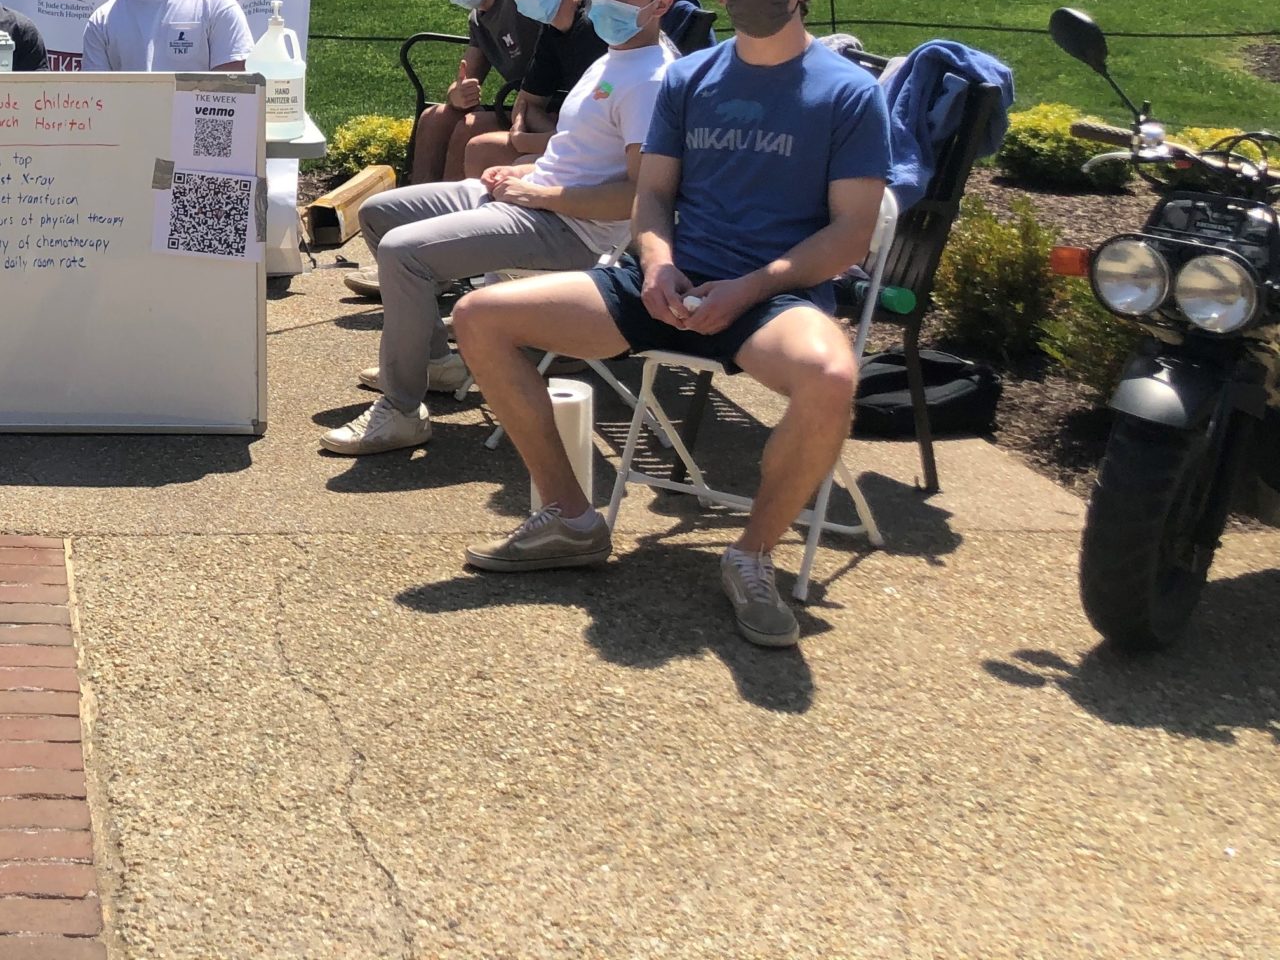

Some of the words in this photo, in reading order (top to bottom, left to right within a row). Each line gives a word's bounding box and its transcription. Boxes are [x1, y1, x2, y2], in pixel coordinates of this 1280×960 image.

[45, 1, 59, 9] Jude
[37, 7, 65, 17] Research
[274, 87, 290, 96] HAND
[195, 94, 211, 102] TKE
[213, 94, 237, 104] WEEK
[195, 106, 235, 118] venmo
[35, 117, 92, 131] Hospital
[685, 127, 753, 151] NIKAU
[753, 129, 794, 157] KAI
[17, 193, 79, 206] transfusion
[20, 214, 34, 226] of
[40, 214, 80, 229] physical
[87, 214, 125, 228] therapy
[1195, 221, 1233, 232] HONDA
[18, 235, 31, 250] of
[36, 234, 110, 255] chemotherapy
[4, 254, 28, 272] daily
[33, 258, 55, 268] room
[59, 254, 87, 269] rate
